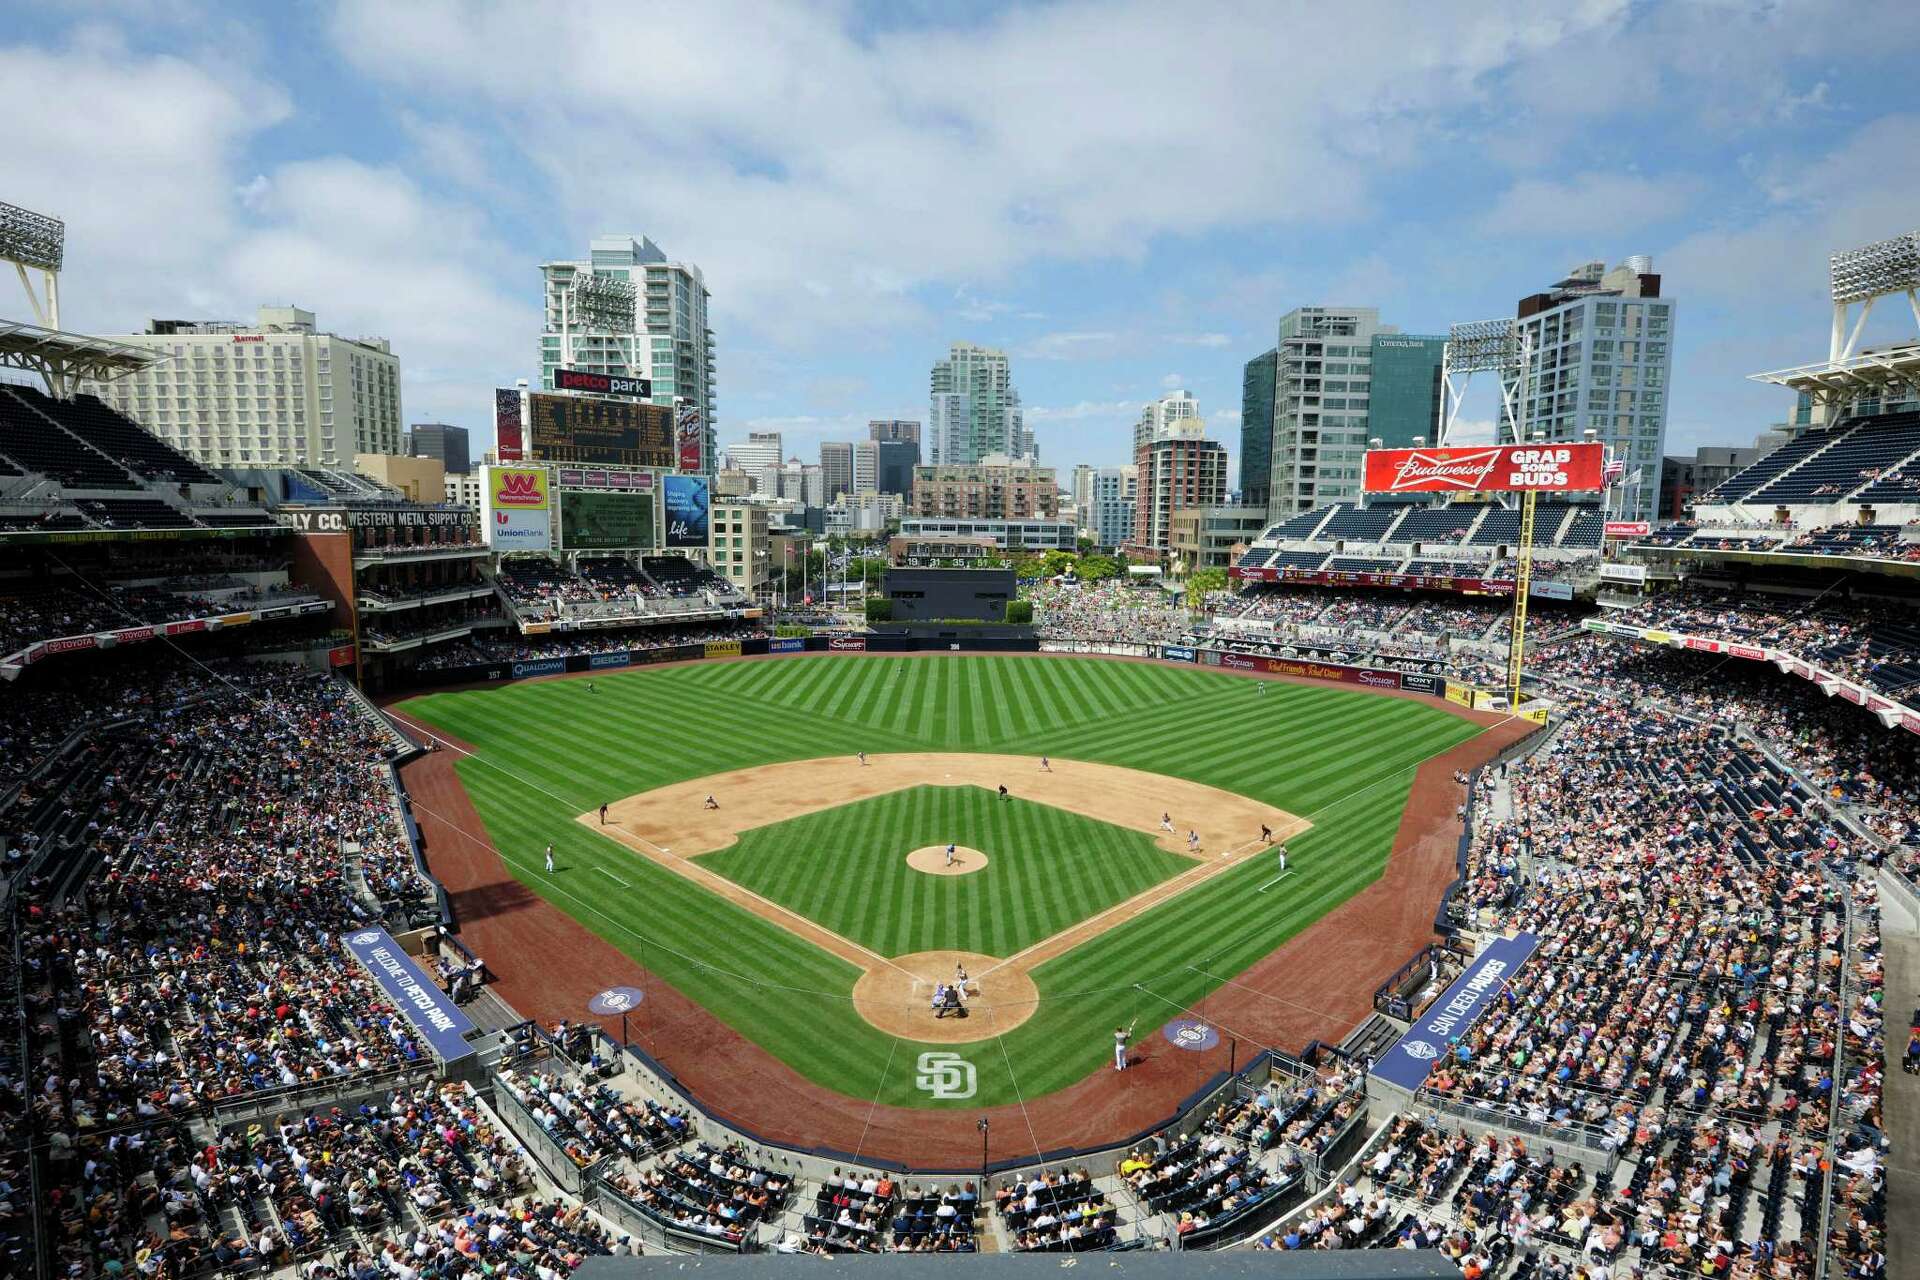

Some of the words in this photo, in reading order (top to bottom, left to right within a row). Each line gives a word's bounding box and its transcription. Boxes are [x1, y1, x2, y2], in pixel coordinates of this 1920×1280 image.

[563, 374, 609, 389] petco
[610, 379, 644, 394] park
[1510, 450, 1571, 464] GRAB
[1394, 461, 1496, 479] Budweiser
[1520, 464, 1559, 472] SOME
[1509, 472, 1569, 486] BUDS
[318, 513, 346, 530] CO.
[348, 512, 395, 526] WESTERN
[398, 512, 427, 526] METAL
[428, 513, 458, 525] SUPPLY
[497, 529, 545, 537] UnionBank
[668, 520, 688, 540] life
[908, 558, 918, 566] 19
[930, 558, 940, 567] 31
[1480, 582, 1514, 593] Sycuan
[123, 631, 150, 641] TOYOTA
[62, 639, 92, 648] TOYOTA
[706, 643, 740, 651] STANLEY
[1738, 647, 1763, 659] TOYOTA
[591, 655, 629, 666] GEICO
[1224, 655, 1255, 668] Sycuan
[1359, 671, 1396, 686] Sycuan
[1406, 676, 1432, 685] SONY
[371, 946, 407, 978] WELCOME
[396, 975, 415, 987] TO
[404, 985, 435, 1010] PETCO
[1428, 1011, 1458, 1036] SAN
[1447, 989, 1479, 1018] DIEGO
[1467, 958, 1507, 992] PADRES
[424, 1007, 456, 1032] PARK
[916, 1052, 978, 1099] SD
